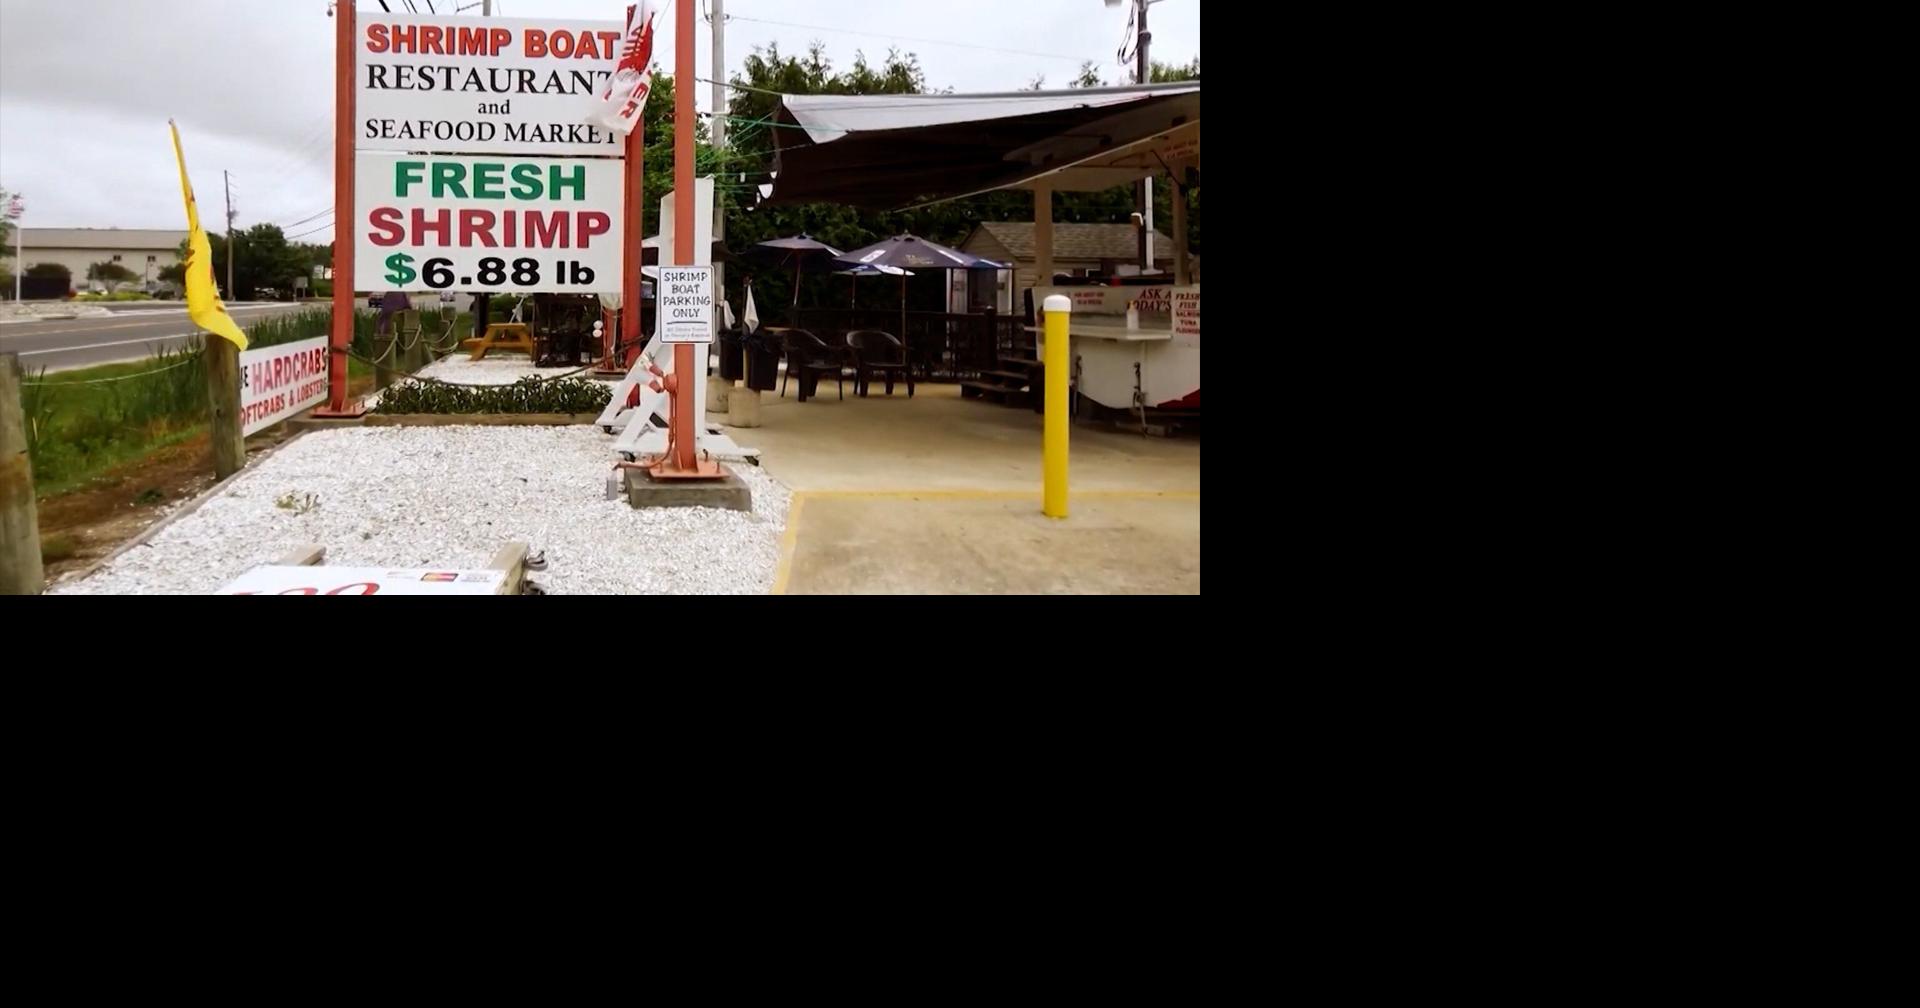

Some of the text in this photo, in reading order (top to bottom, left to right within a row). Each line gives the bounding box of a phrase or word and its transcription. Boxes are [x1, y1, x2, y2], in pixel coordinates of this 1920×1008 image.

[366, 23, 512, 56] SHRIMP
[524, 29, 621, 60] BOAT
[477, 99, 511, 116] and
[366, 119, 496, 142] SEAFOOD
[395, 161, 586, 202] FRESH
[368, 207, 611, 249] SHRIMP
[384, 252, 595, 288] $6.88 lb
[664, 272, 708, 282] SHRIMP
[671, 284, 700, 294] BOAT
[1139, 288, 1162, 299] ASK
[663, 296, 711, 306] PARKING
[672, 308, 701, 318] ONLY
[252, 346, 327, 396] HARDCRABS
[240, 393, 285, 426] OFTCRABS
